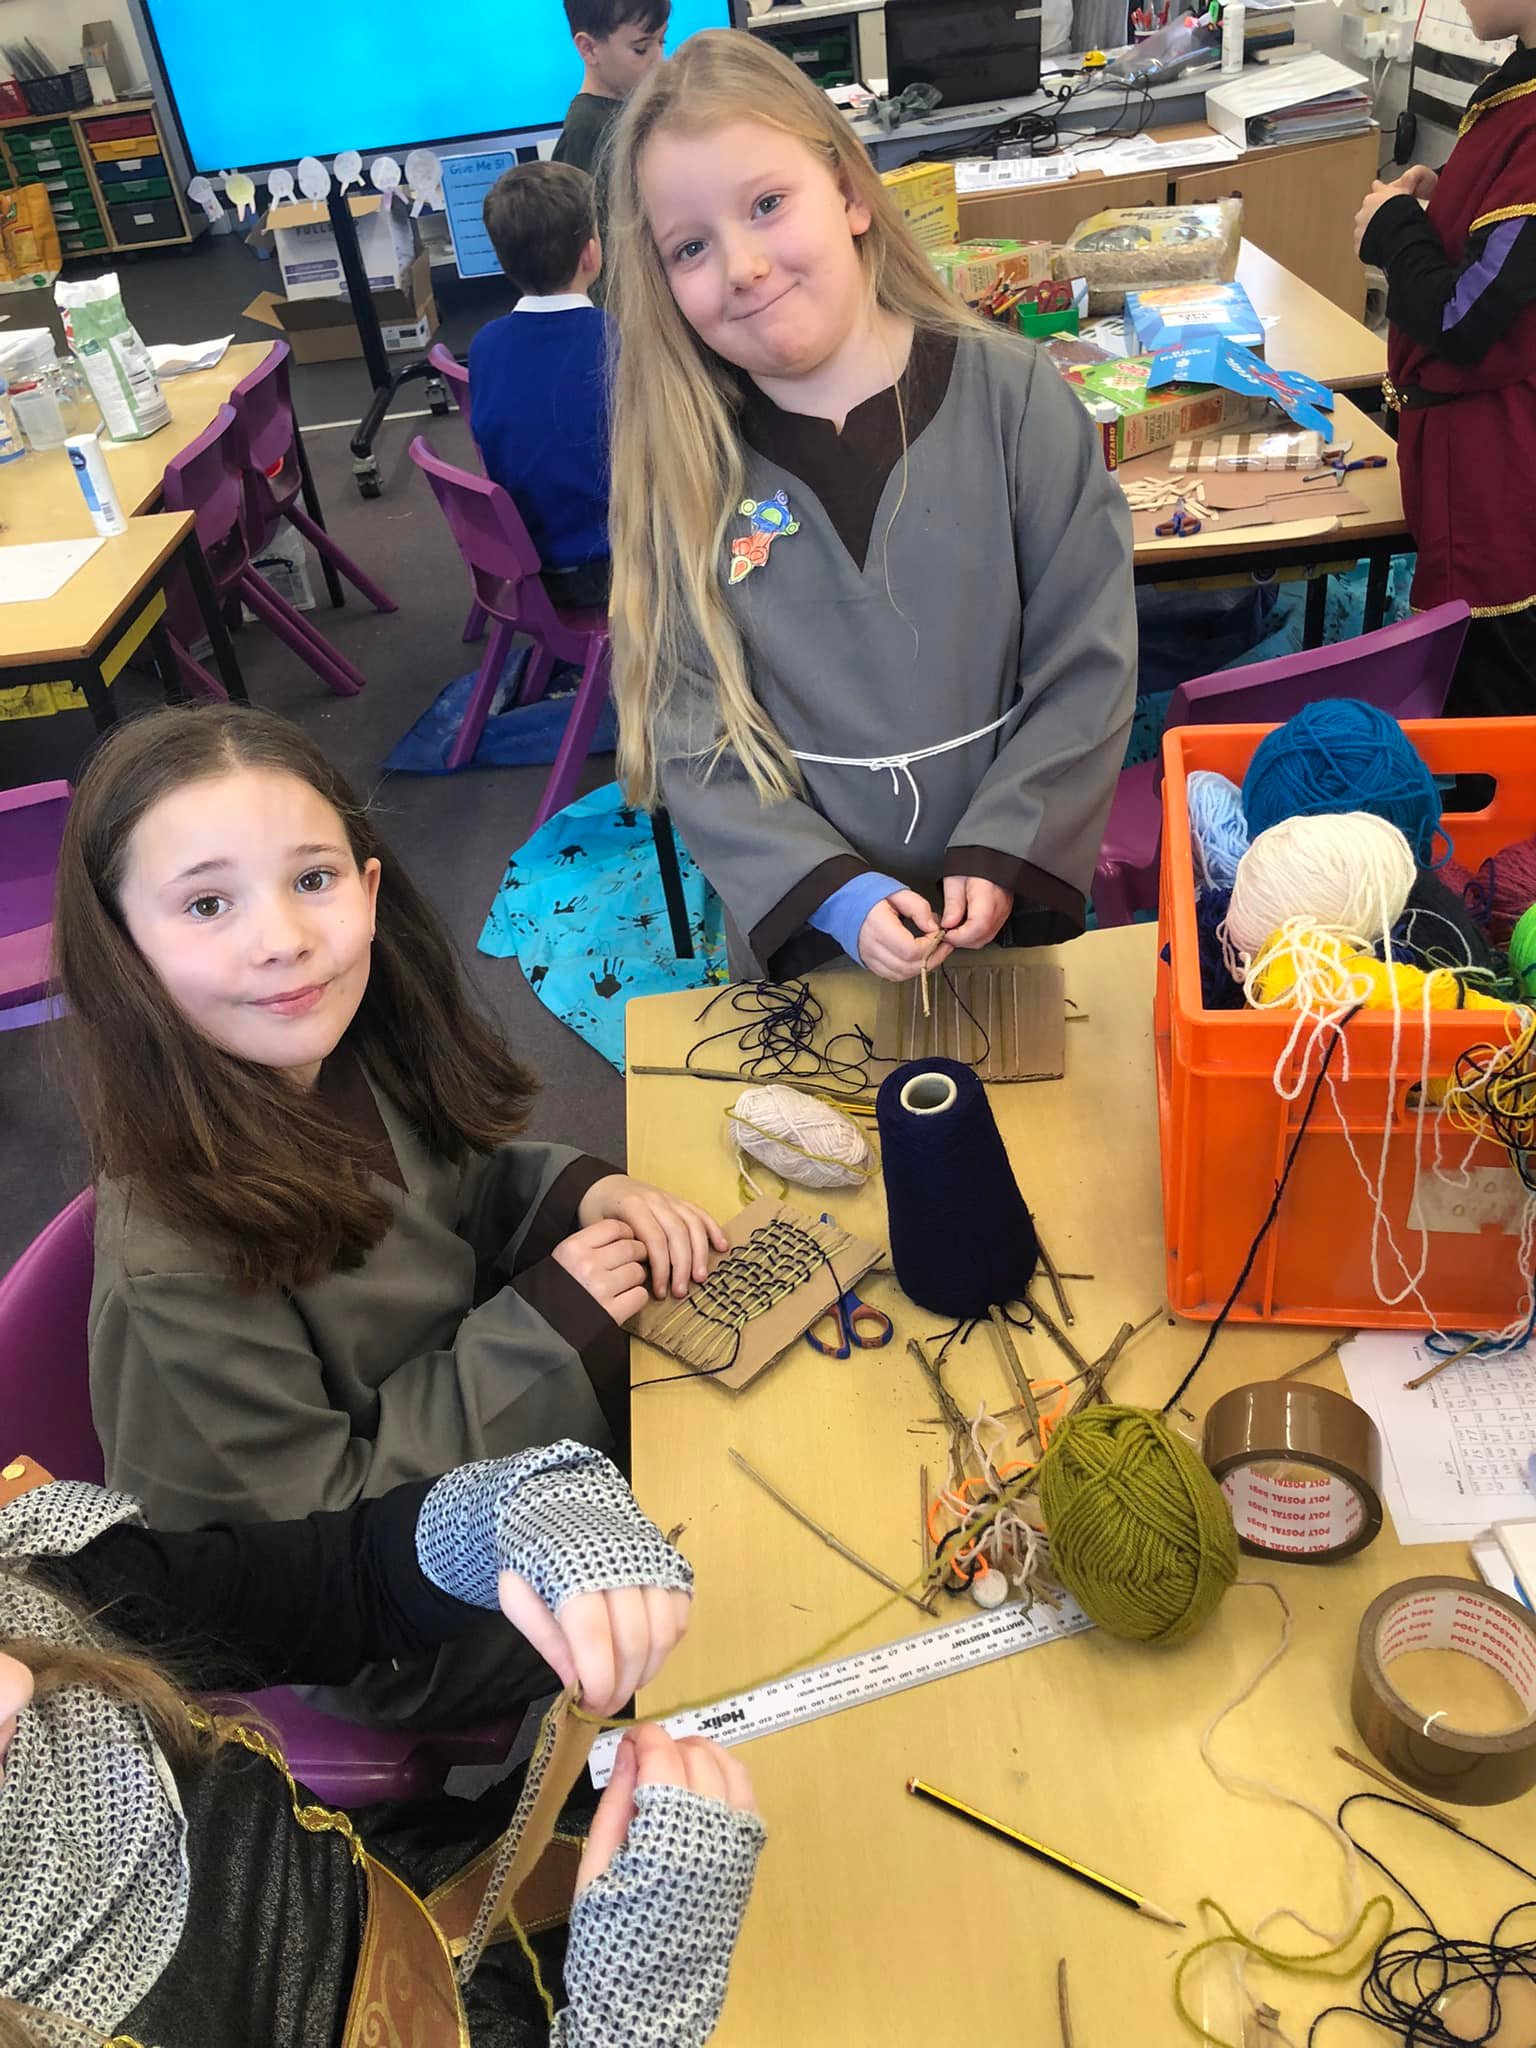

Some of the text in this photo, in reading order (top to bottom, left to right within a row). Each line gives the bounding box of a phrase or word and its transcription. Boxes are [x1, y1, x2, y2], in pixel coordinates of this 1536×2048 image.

[476, 161, 491, 171] Me
[1108, 427, 1116, 468] WIZARD
[1248, 1484, 1269, 1499] bags
[1271, 1493, 1306, 1505] POSTAL
[1309, 1494, 1331, 1505] POLY
[1247, 1500, 1268, 1514] bags
[1271, 1509, 1306, 1521] POSTAL
[1309, 1510, 1331, 1521] POLY
[1270, 1525, 1305, 1537] POSTAL
[1308, 1527, 1331, 1537] POLY
[1457, 1595, 1485, 1608] POLY
[1487, 1604, 1522, 1634] POSTAL
[951, 1619, 1026, 1649] SHATTER RESISTANT
[1455, 1608, 1482, 1621] POLY
[1485, 1618, 1519, 1648] POSTAL
[1452, 1621, 1480, 1634] POLY
[1482, 1631, 1516, 1660] POSTAL
[950, 1654, 964, 1662] 100
[1450, 1633, 1477, 1647] POLY
[1480, 1644, 1513, 1674] POSTAL
[934, 1659, 947, 1667] 110
